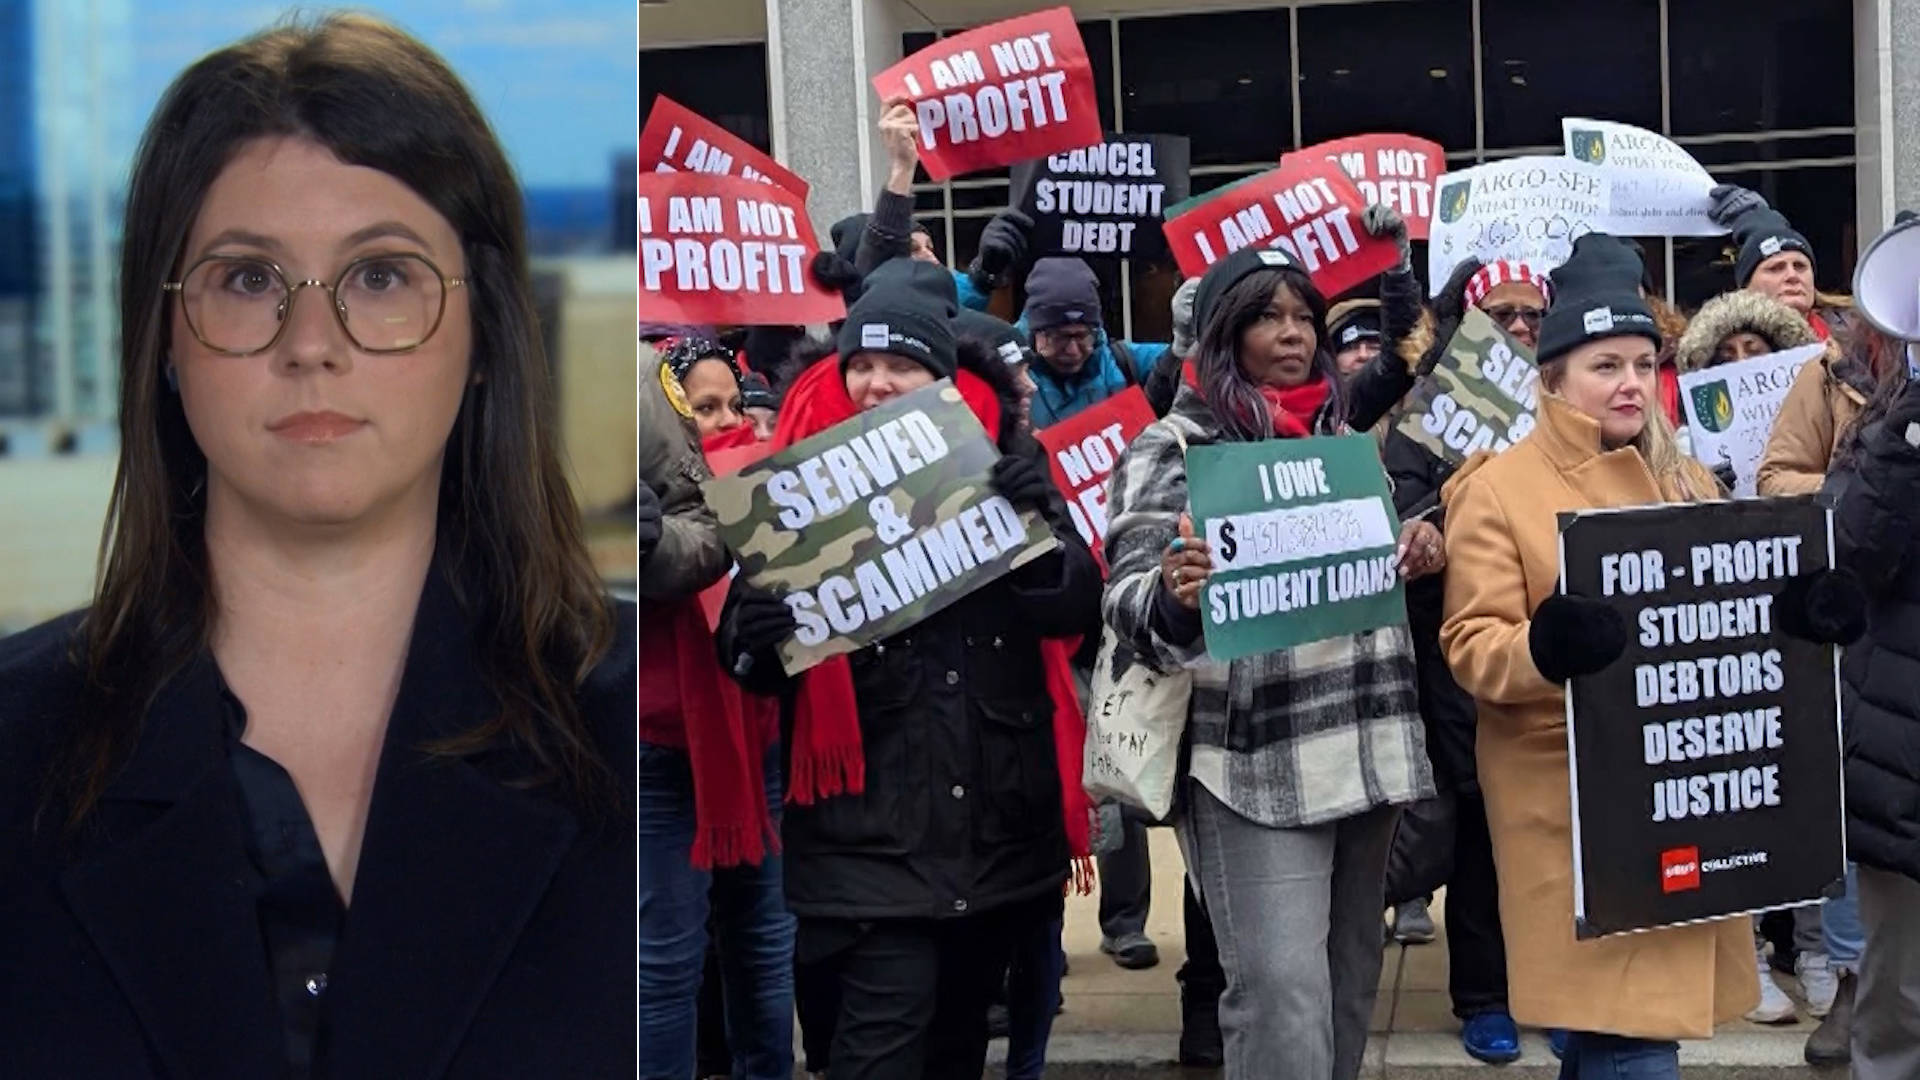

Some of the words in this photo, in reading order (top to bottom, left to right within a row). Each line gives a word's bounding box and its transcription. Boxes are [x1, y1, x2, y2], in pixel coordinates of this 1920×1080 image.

[904, 73, 922, 96] I
[929, 50, 985, 91] AM
[990, 31, 1056, 77] NOT
[915, 70, 1068, 151] PROFIT
[663, 125, 683, 159] I
[684, 139, 734, 175] AM
[1048, 142, 1157, 177] CANCEL
[1377, 149, 1428, 179] NOT
[639, 196, 652, 233] I
[668, 196, 724, 233] AM
[736, 197, 798, 240] NOT
[1035, 178, 1165, 217] STUDENT
[1194, 231, 1216, 265] I
[1219, 203, 1273, 255] AM
[1274, 177, 1338, 225] NOT
[1062, 219, 1136, 253] DEBT
[641, 238, 806, 294] PROFIT
[1422, 393, 1510, 457] SCA
[766, 409, 949, 531] SERVED
[1057, 422, 1128, 488] NOT
[1258, 463, 1273, 503] I
[1273, 457, 1331, 501] OWE
[867, 494, 915, 545] &
[783, 494, 1027, 647] SCAMMED
[1208, 567, 1322, 625] STUDENT
[1327, 553, 1398, 602] LOANS
[1601, 548, 1665, 596] FOR
[1691, 535, 1802, 587] PROFIT
[1638, 594, 1773, 648] STUDENT
[1635, 648, 1784, 708] DEBTORS
[1118, 731, 1148, 757] PAY
[1642, 706, 1784, 765] DESERVE
[1651, 763, 1782, 822] JUSTICE
